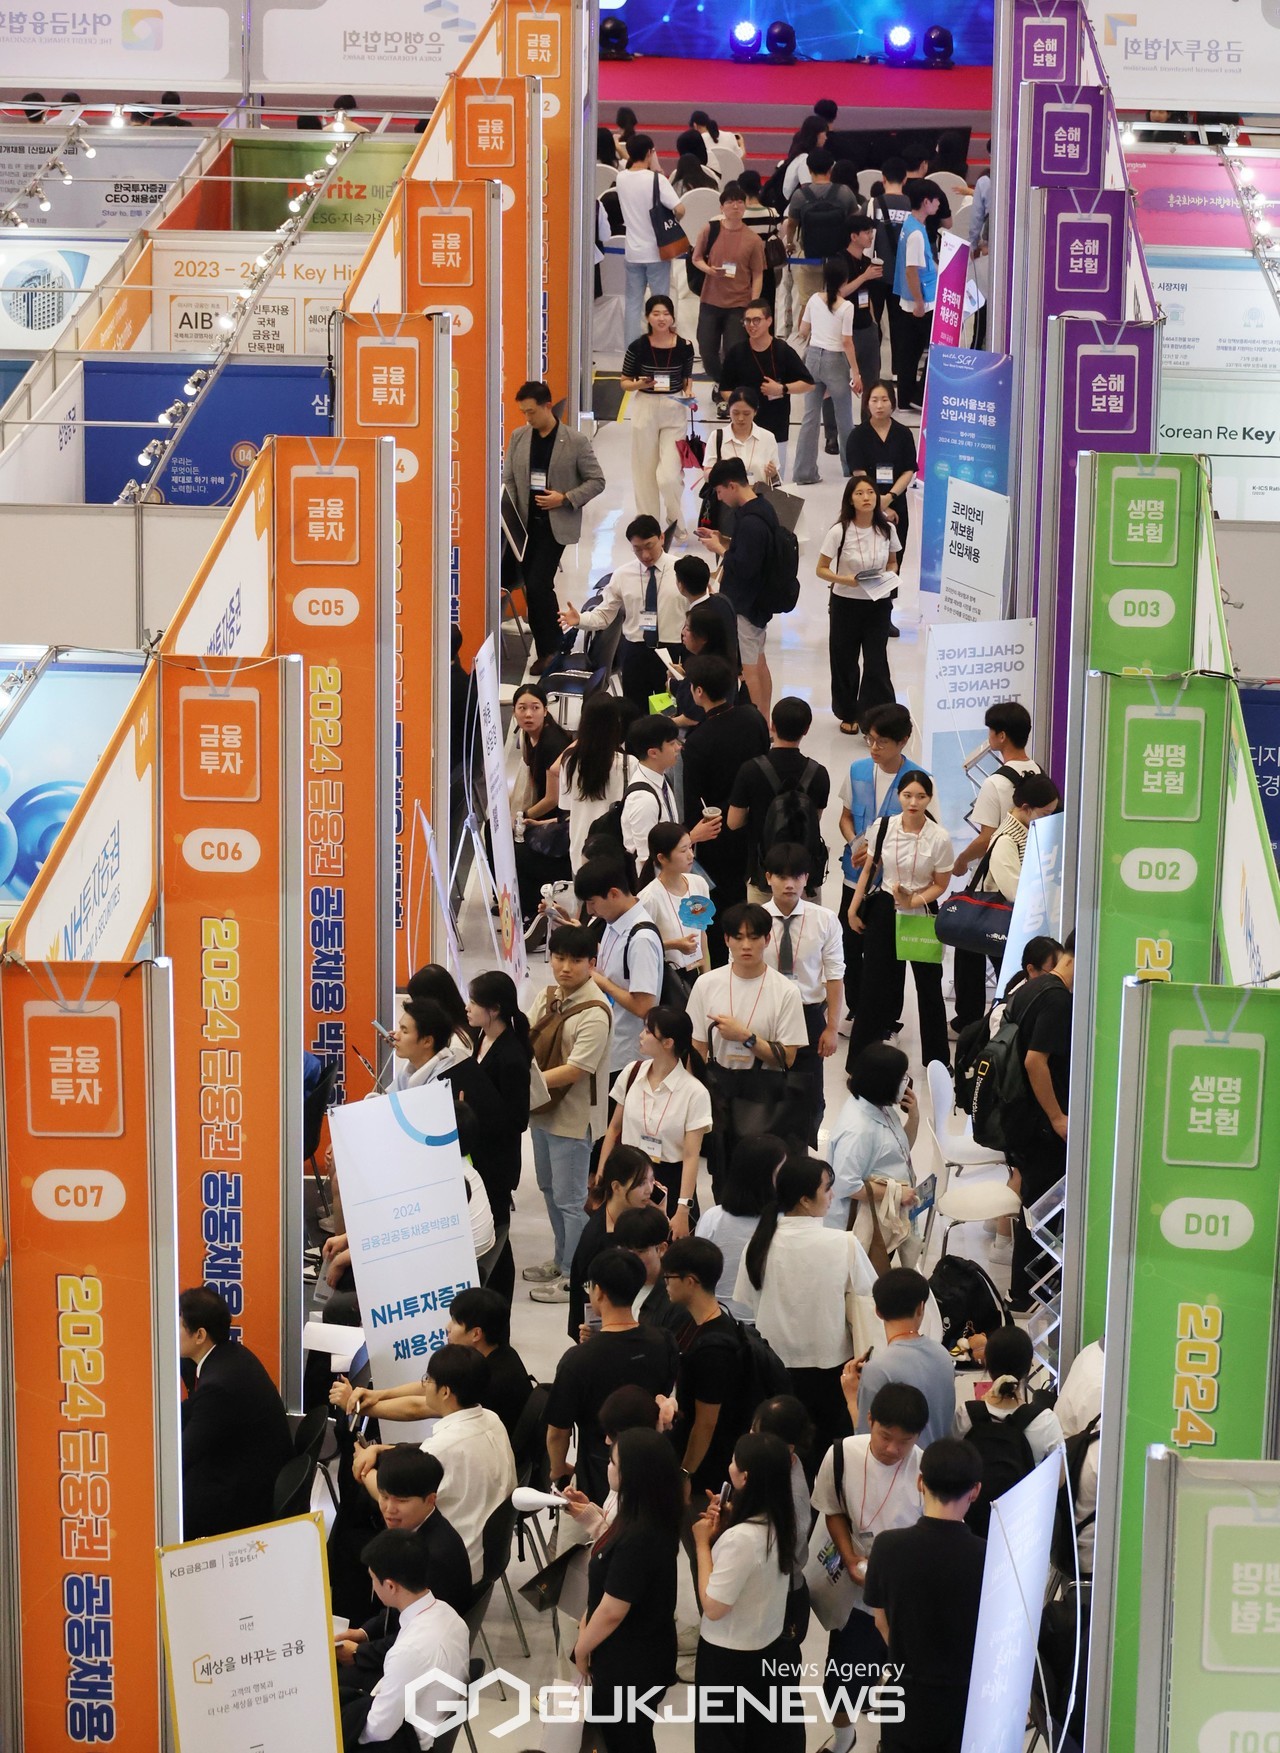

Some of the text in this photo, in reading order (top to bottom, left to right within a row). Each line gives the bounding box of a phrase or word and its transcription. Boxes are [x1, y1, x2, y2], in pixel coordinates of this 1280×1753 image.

[527, 34, 551, 48] 금융
[1033, 39, 1057, 52] 손해
[527, 48, 552, 63] 투자
[1032, 53, 1056, 68] 보험
[477, 119, 504, 134] 금융
[1054, 126, 1081, 142] 손해
[477, 136, 504, 151] 투자
[1054, 144, 1080, 159] 보험
[114, 183, 167, 194] 한국투자증권
[105, 194, 129, 204] CEO
[431, 233, 461, 250] 금융
[1070, 239, 1100, 256] 손해
[431, 252, 462, 269] 투자
[1069, 257, 1098, 275] 보험
[174, 260, 220, 278] 2023
[294, 264, 326, 284] Key
[1158, 282, 1188, 292] 시장지위
[253, 304, 290, 316] 인투자용
[256, 317, 276, 328] 국채
[252, 330, 280, 340] 금융권
[372, 366, 406, 386] 금융
[1091, 374, 1125, 393] 손해
[311, 394, 330, 416] 삼
[372, 388, 406, 406] 투자
[942, 395, 996, 413] SGI서울보증
[1090, 396, 1124, 414] 보험
[940, 408, 997, 428] 신입사원 채용
[1160, 424, 1276, 444] Korean Re Key
[307, 498, 344, 519] 금융
[952, 500, 984, 526] 코리안리
[1126, 499, 1164, 521] 생명
[307, 520, 346, 542] 투자
[950, 520, 975, 542] 재보험
[1126, 522, 1164, 544] 보험
[948, 541, 980, 564] 신입채용
[308, 599, 346, 616] C05
[1123, 601, 1160, 618] D03
[198, 724, 243, 750] 금융
[198, 752, 244, 776] 투자
[1142, 743, 1186, 768] 생명
[1141, 769, 1185, 796] 보험
[308, 665, 347, 1014] 2024 금융권 공동채용
[200, 841, 244, 862] C06
[1138, 861, 1181, 881] D02
[64, 820, 120, 961] NH투자증권
[200, 916, 240, 1041] 2024
[48, 1044, 102, 1075] 금융
[48, 1076, 103, 1108] 투자
[1189, 1075, 1242, 1105] 생명
[200, 1048, 242, 1162] 금융권
[1187, 1108, 1240, 1137] 보험
[54, 1183, 105, 1208] C07
[392, 1202, 422, 1220] 2024
[360, 1214, 460, 1252] 금융권공동채용박람회
[1184, 1213, 1230, 1238] D01
[1170, 1302, 1222, 1448] 2024
[56, 1272, 116, 1744] 2024 금융권 공동채용
[170, 1558, 217, 1578] KB금융그룹
[240, 1621, 254, 1632] 미션
[200, 1639, 306, 1678] 세상을 바꾸는 금융
[230, 1680, 274, 1698] 고객의 행복과
[216, 1704, 230, 1715] 나은
[232, 1698, 253, 1711] 세상을
